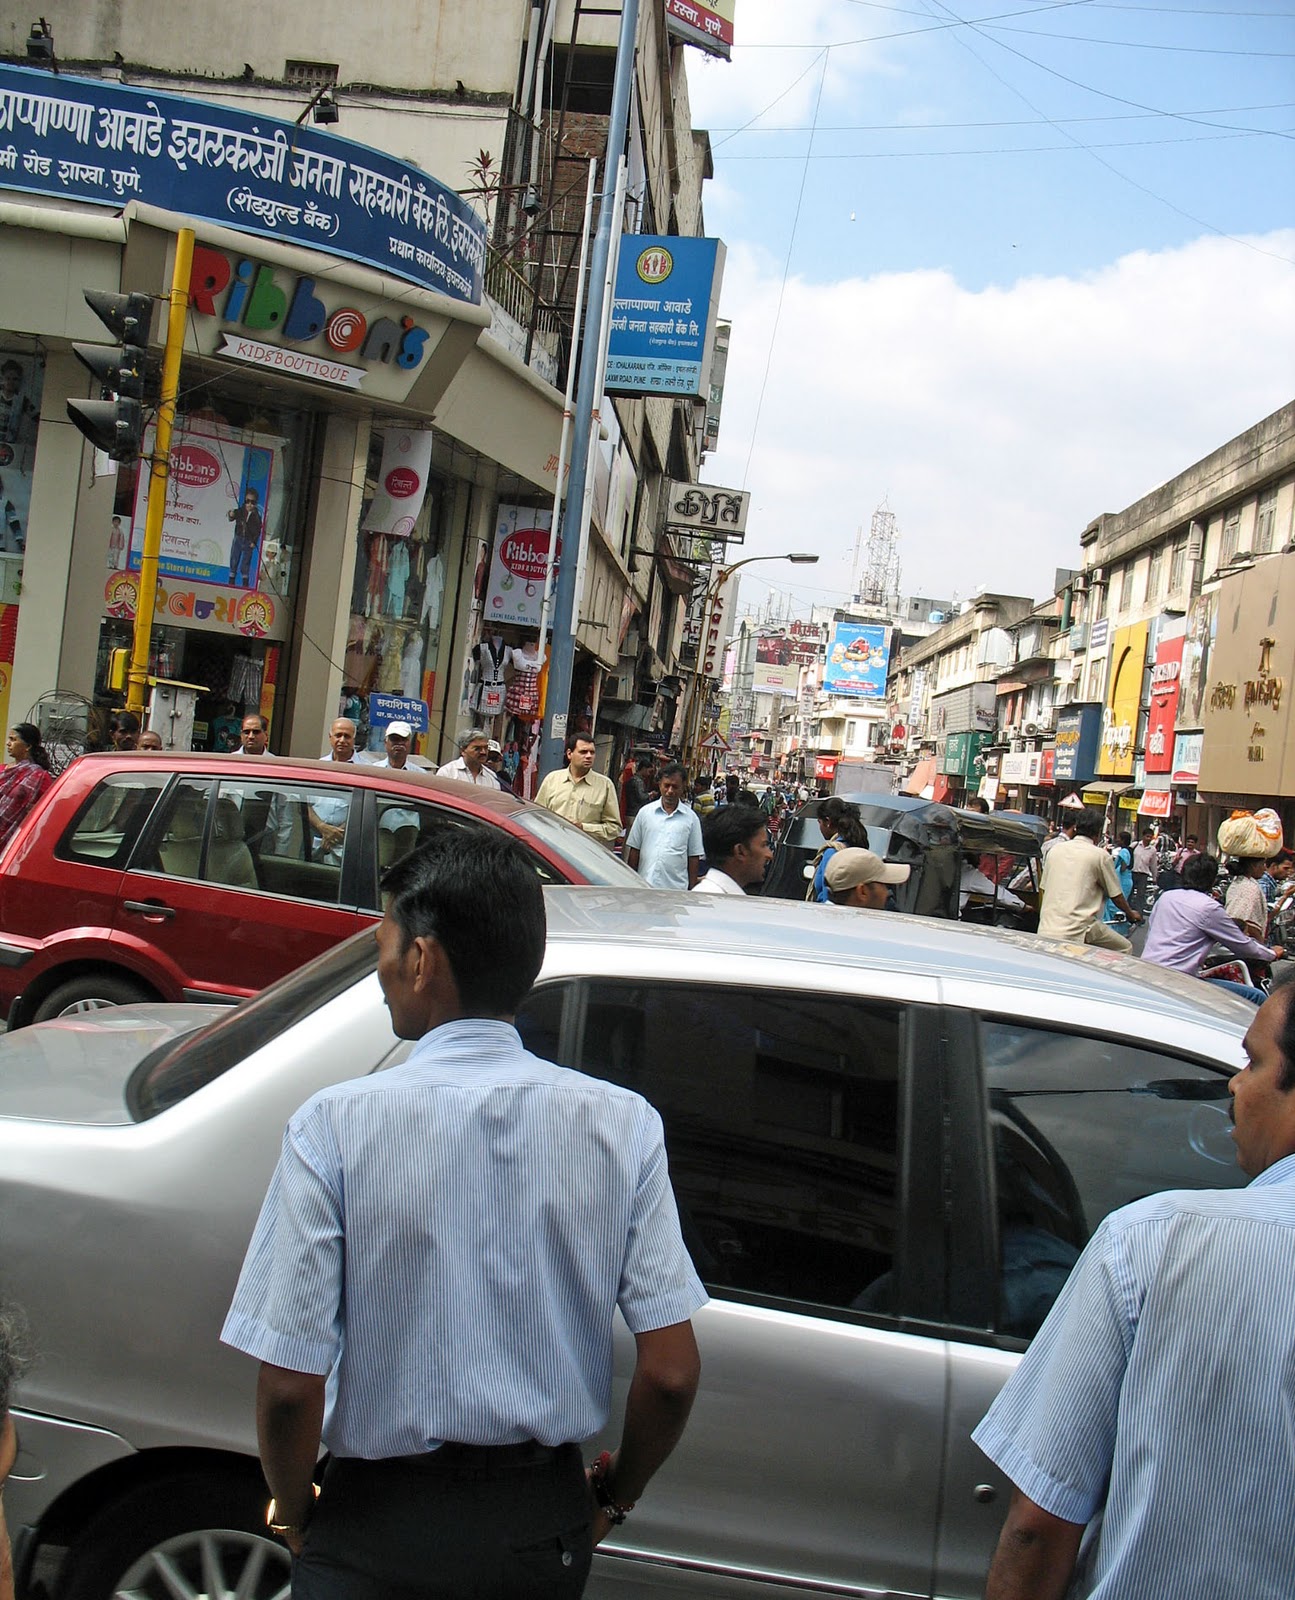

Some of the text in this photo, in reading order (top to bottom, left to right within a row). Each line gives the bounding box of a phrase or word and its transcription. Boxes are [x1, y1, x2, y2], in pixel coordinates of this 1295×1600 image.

[23, 149, 52, 176] रोड
[58, 160, 109, 189] शाखा,
[111, 166, 143, 195] पुणे.
[95, 101, 166, 157] आवाडे
[168, 119, 289, 184] इचलकरंजी
[289, 145, 347, 200] जनता
[349, 164, 413, 225] सहकारी
[412, 181, 436, 233] बँक
[389, 236, 415, 262] प्रधान
[188, 246, 431, 371] Ribbon's
[663, 298, 692, 315] आवाडे
[629, 319, 648, 332] जनता
[649, 318, 674, 335] सहकारी
[675, 318, 688, 335] बँक
[377, 698, 422, 712] सदाशिव पेठ
